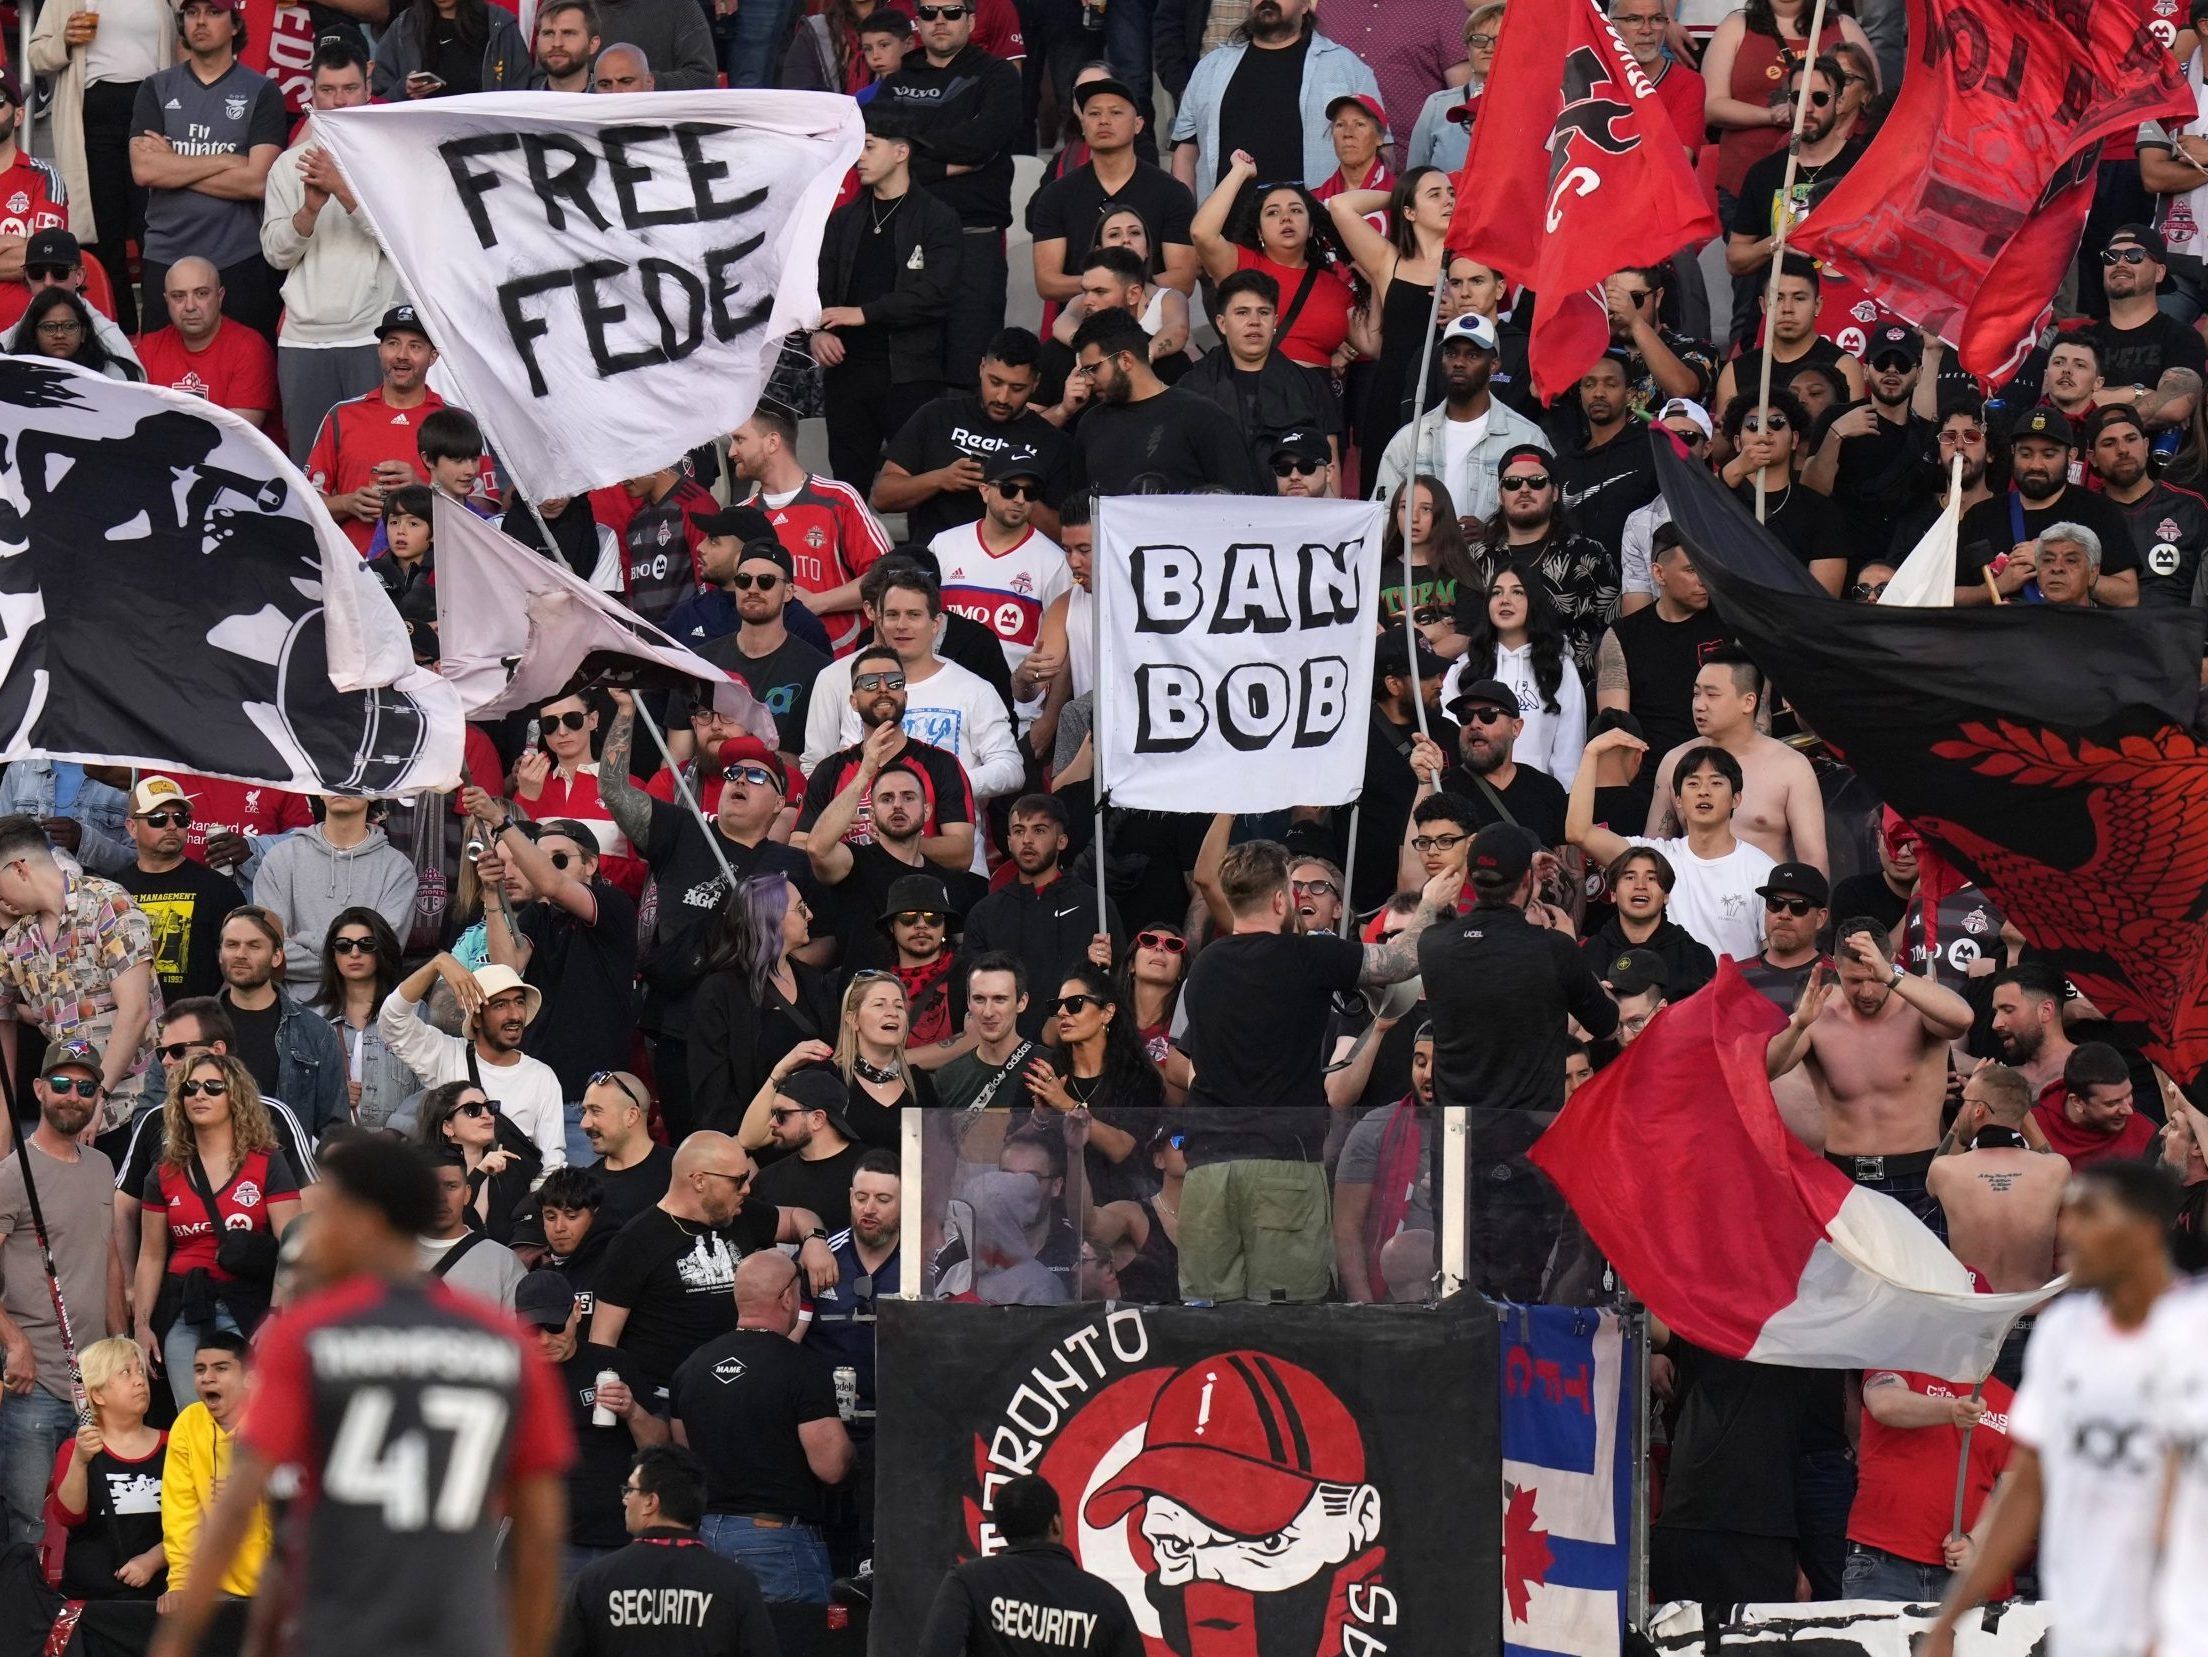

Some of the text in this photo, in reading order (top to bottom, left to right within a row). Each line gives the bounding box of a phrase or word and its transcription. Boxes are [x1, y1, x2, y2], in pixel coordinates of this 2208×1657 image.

[892, 85, 941, 98] VOLVO
[167, 136, 237, 156] mirates
[189, 124, 211, 140] Fly
[438, 122, 769, 250] FREE
[496, 231, 776, 398] FEDE
[1129, 536, 1364, 634] BAN
[1133, 656, 1348, 753] BOB
[139, 892, 197, 903] MANAGEMENT
[1005, 1041, 1034, 1070] adidas
[715, 1365, 742, 1374] MAME
[322, 1384, 510, 1534] 47
[608, 1587, 714, 1628] SECURITY
[990, 1595, 1098, 1649] SECURITY
